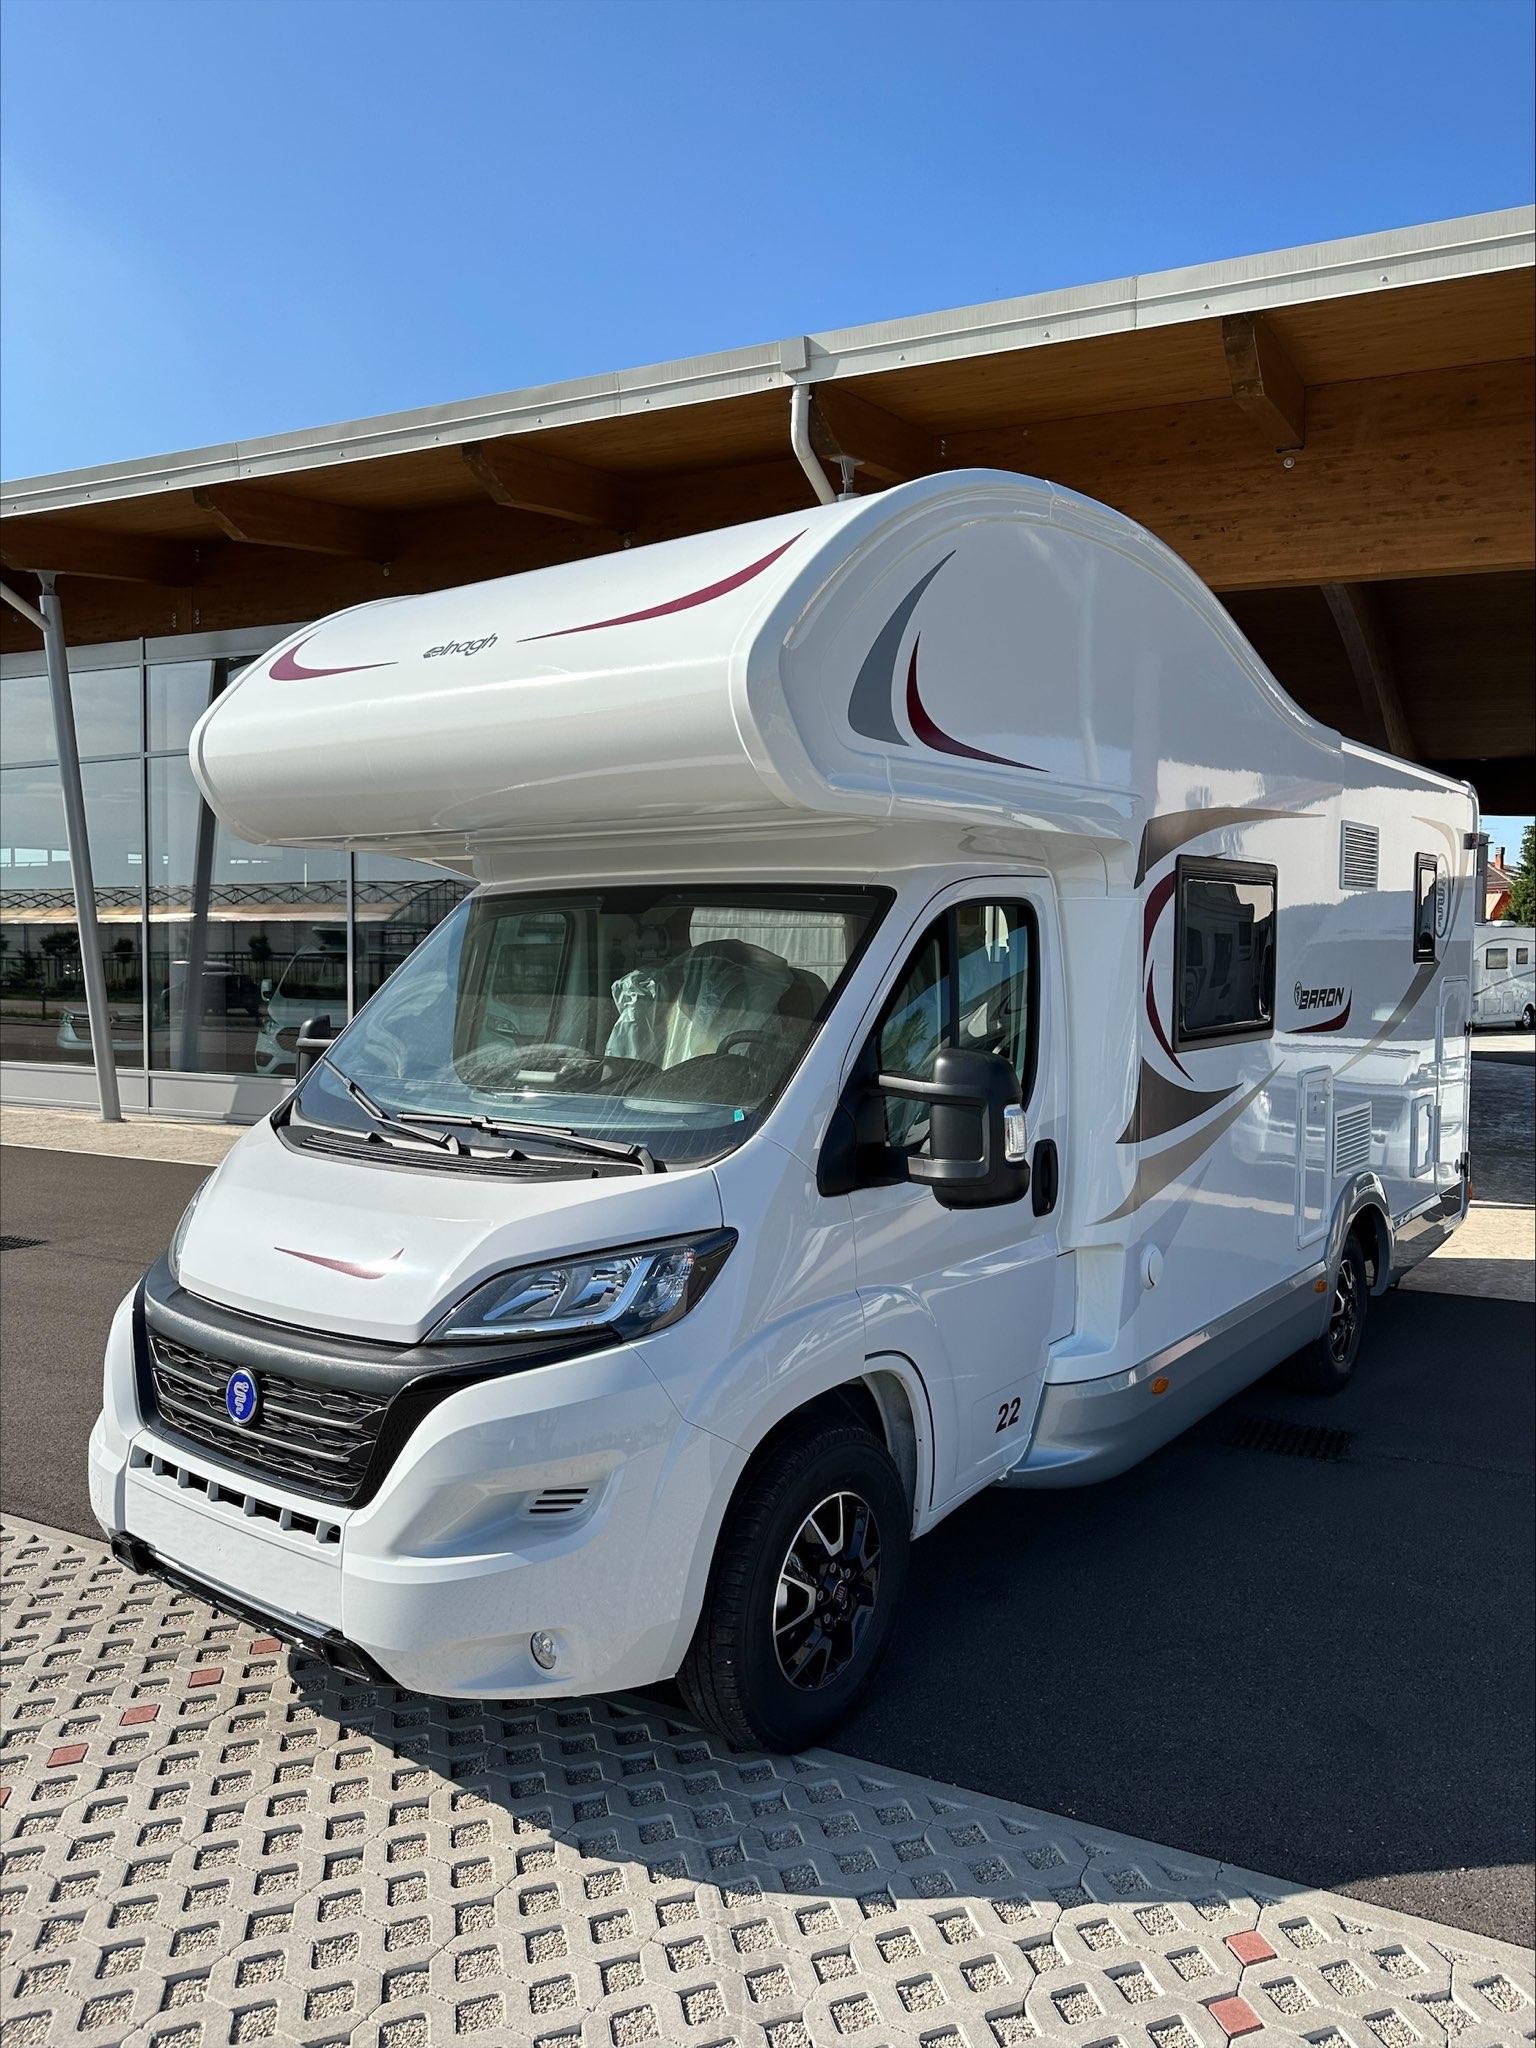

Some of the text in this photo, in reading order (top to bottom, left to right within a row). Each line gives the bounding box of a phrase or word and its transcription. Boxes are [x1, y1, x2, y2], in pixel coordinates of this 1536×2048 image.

[423, 633, 498, 658] elnagh
[1298, 987, 1344, 1010] BARON
[995, 1397, 1021, 1433] 22
